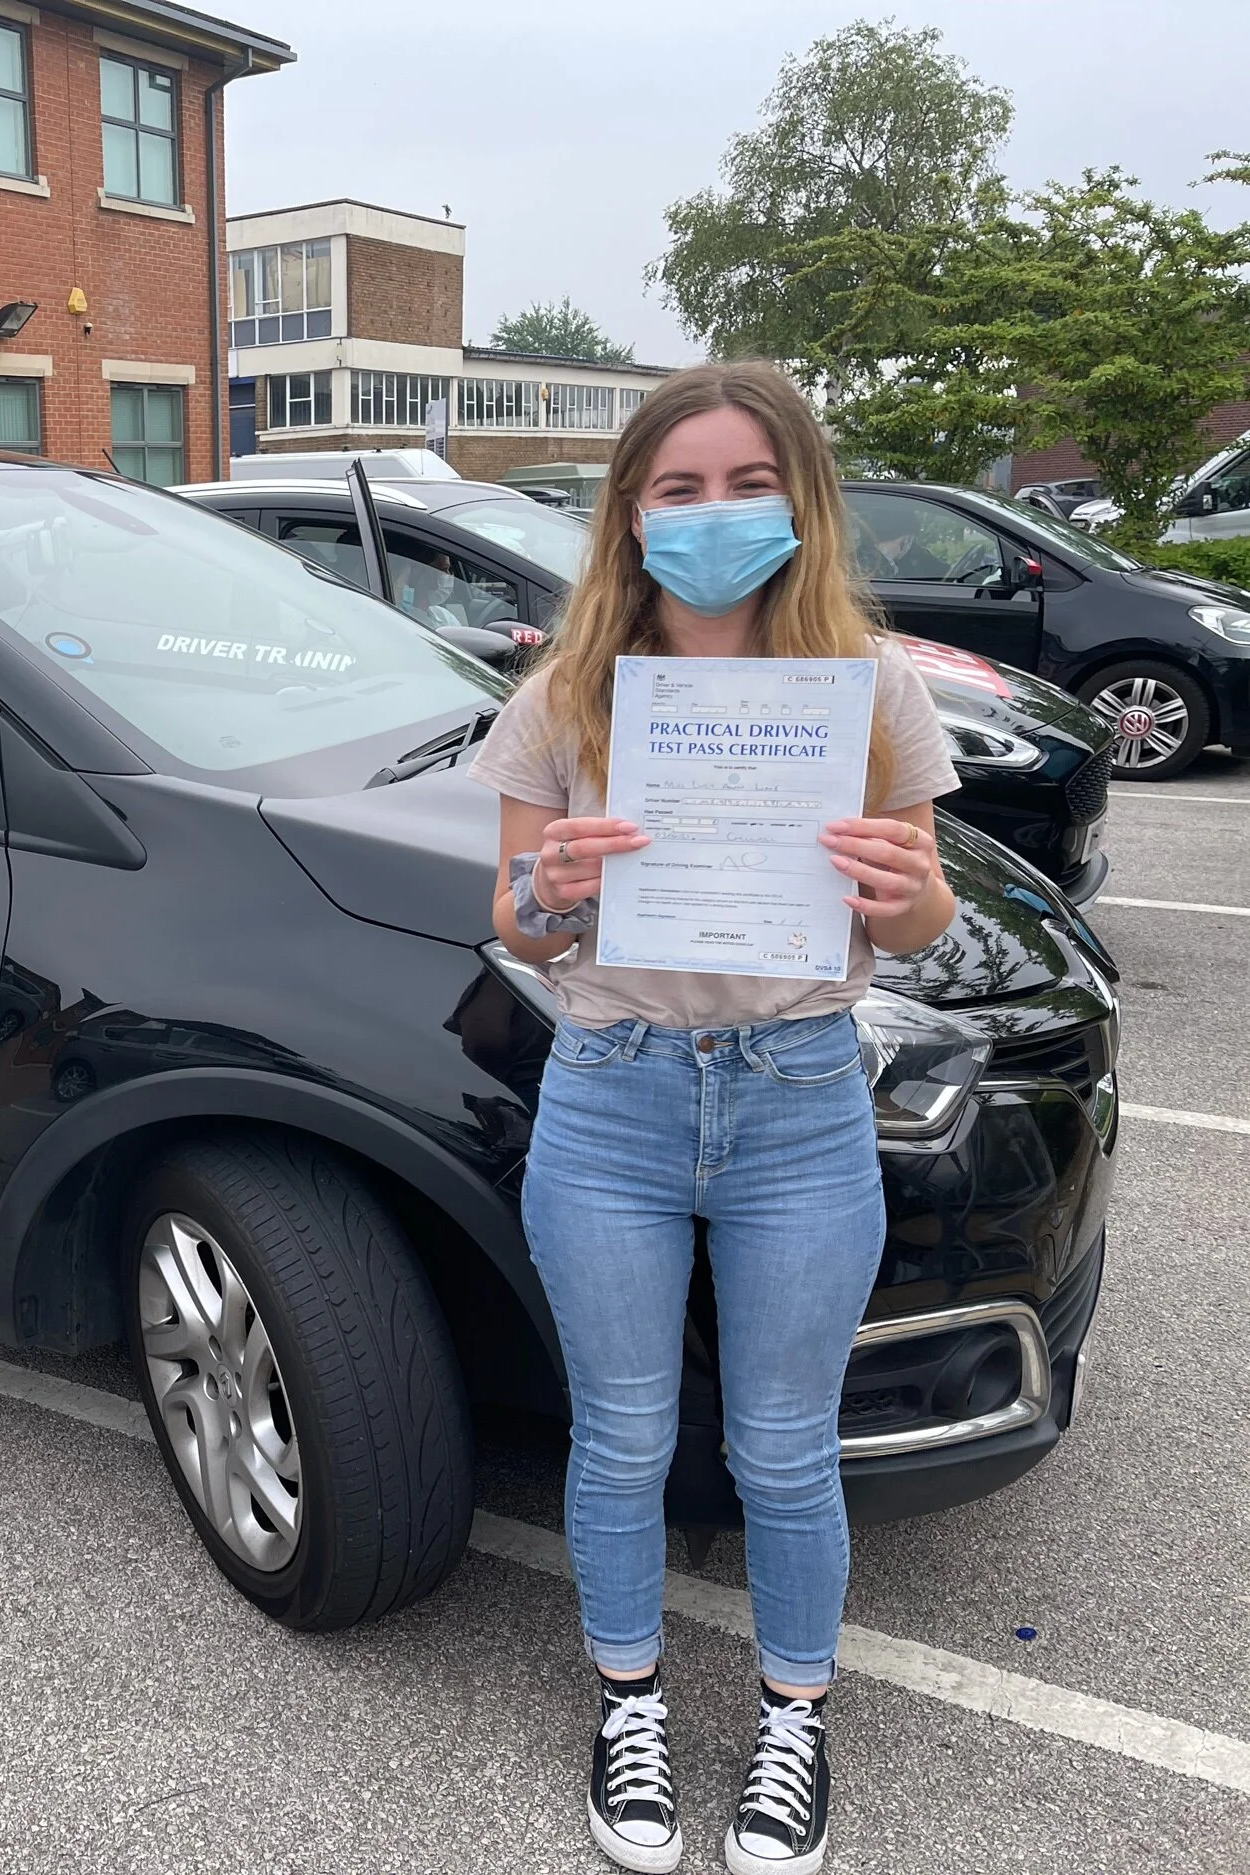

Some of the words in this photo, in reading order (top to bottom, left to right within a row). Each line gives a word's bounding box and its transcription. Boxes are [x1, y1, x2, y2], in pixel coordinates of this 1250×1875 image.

[513, 630, 543, 644] RED
[157, 634, 247, 660] DRIVER
[650, 722, 743, 737] PRACTICAL
[750, 724, 829, 739] DRIVING
[650, 741, 683, 754] TEST
[688, 742, 724, 755] PASS
[729, 743, 827, 758] CERTIFICATE
[699, 931, 746, 941] IMPORTANT
